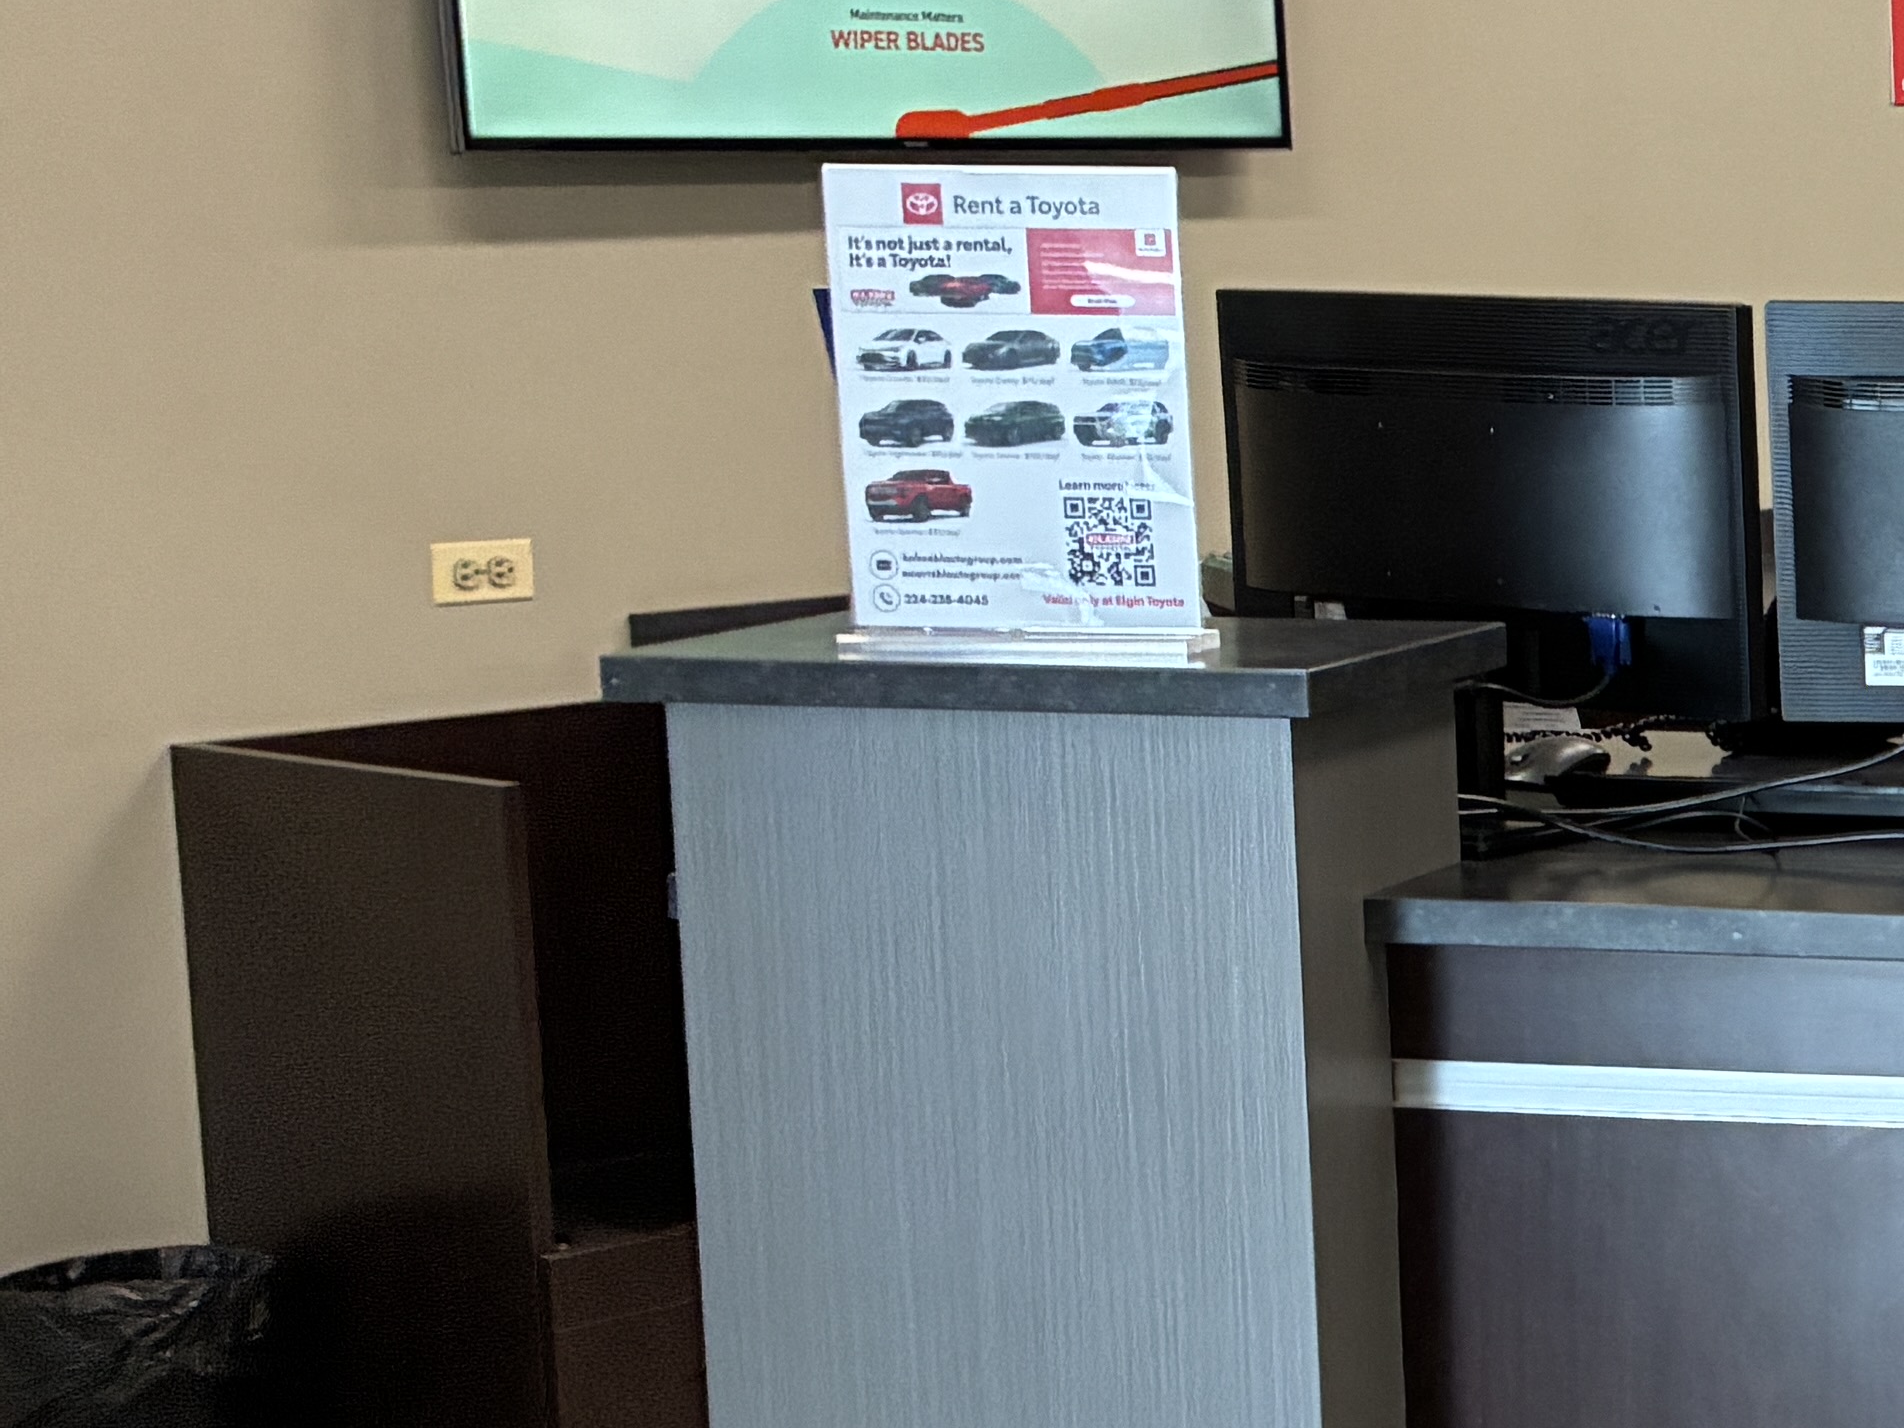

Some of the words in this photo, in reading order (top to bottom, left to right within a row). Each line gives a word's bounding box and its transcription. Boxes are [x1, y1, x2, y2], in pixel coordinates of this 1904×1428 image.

[830, 29, 900, 51] WIPER
[905, 31, 985, 53] BLADES
[953, 195, 1004, 215] Rent
[1009, 200, 1022, 215] a
[1025, 195, 1100, 220] Toyota
[848, 235, 873, 251] It's
[875, 237, 905, 251] not
[907, 235, 939, 255] just
[942, 240, 953, 251] a
[956, 236, 1012, 255] rental,
[849, 253, 874, 268] It's
[877, 257, 887, 268] a
[889, 253, 952, 272] Toyota!
[1059, 479, 1091, 491] Learn
[1116, 595, 1144, 608] Elgin
[1147, 595, 1184, 609] Toyota
